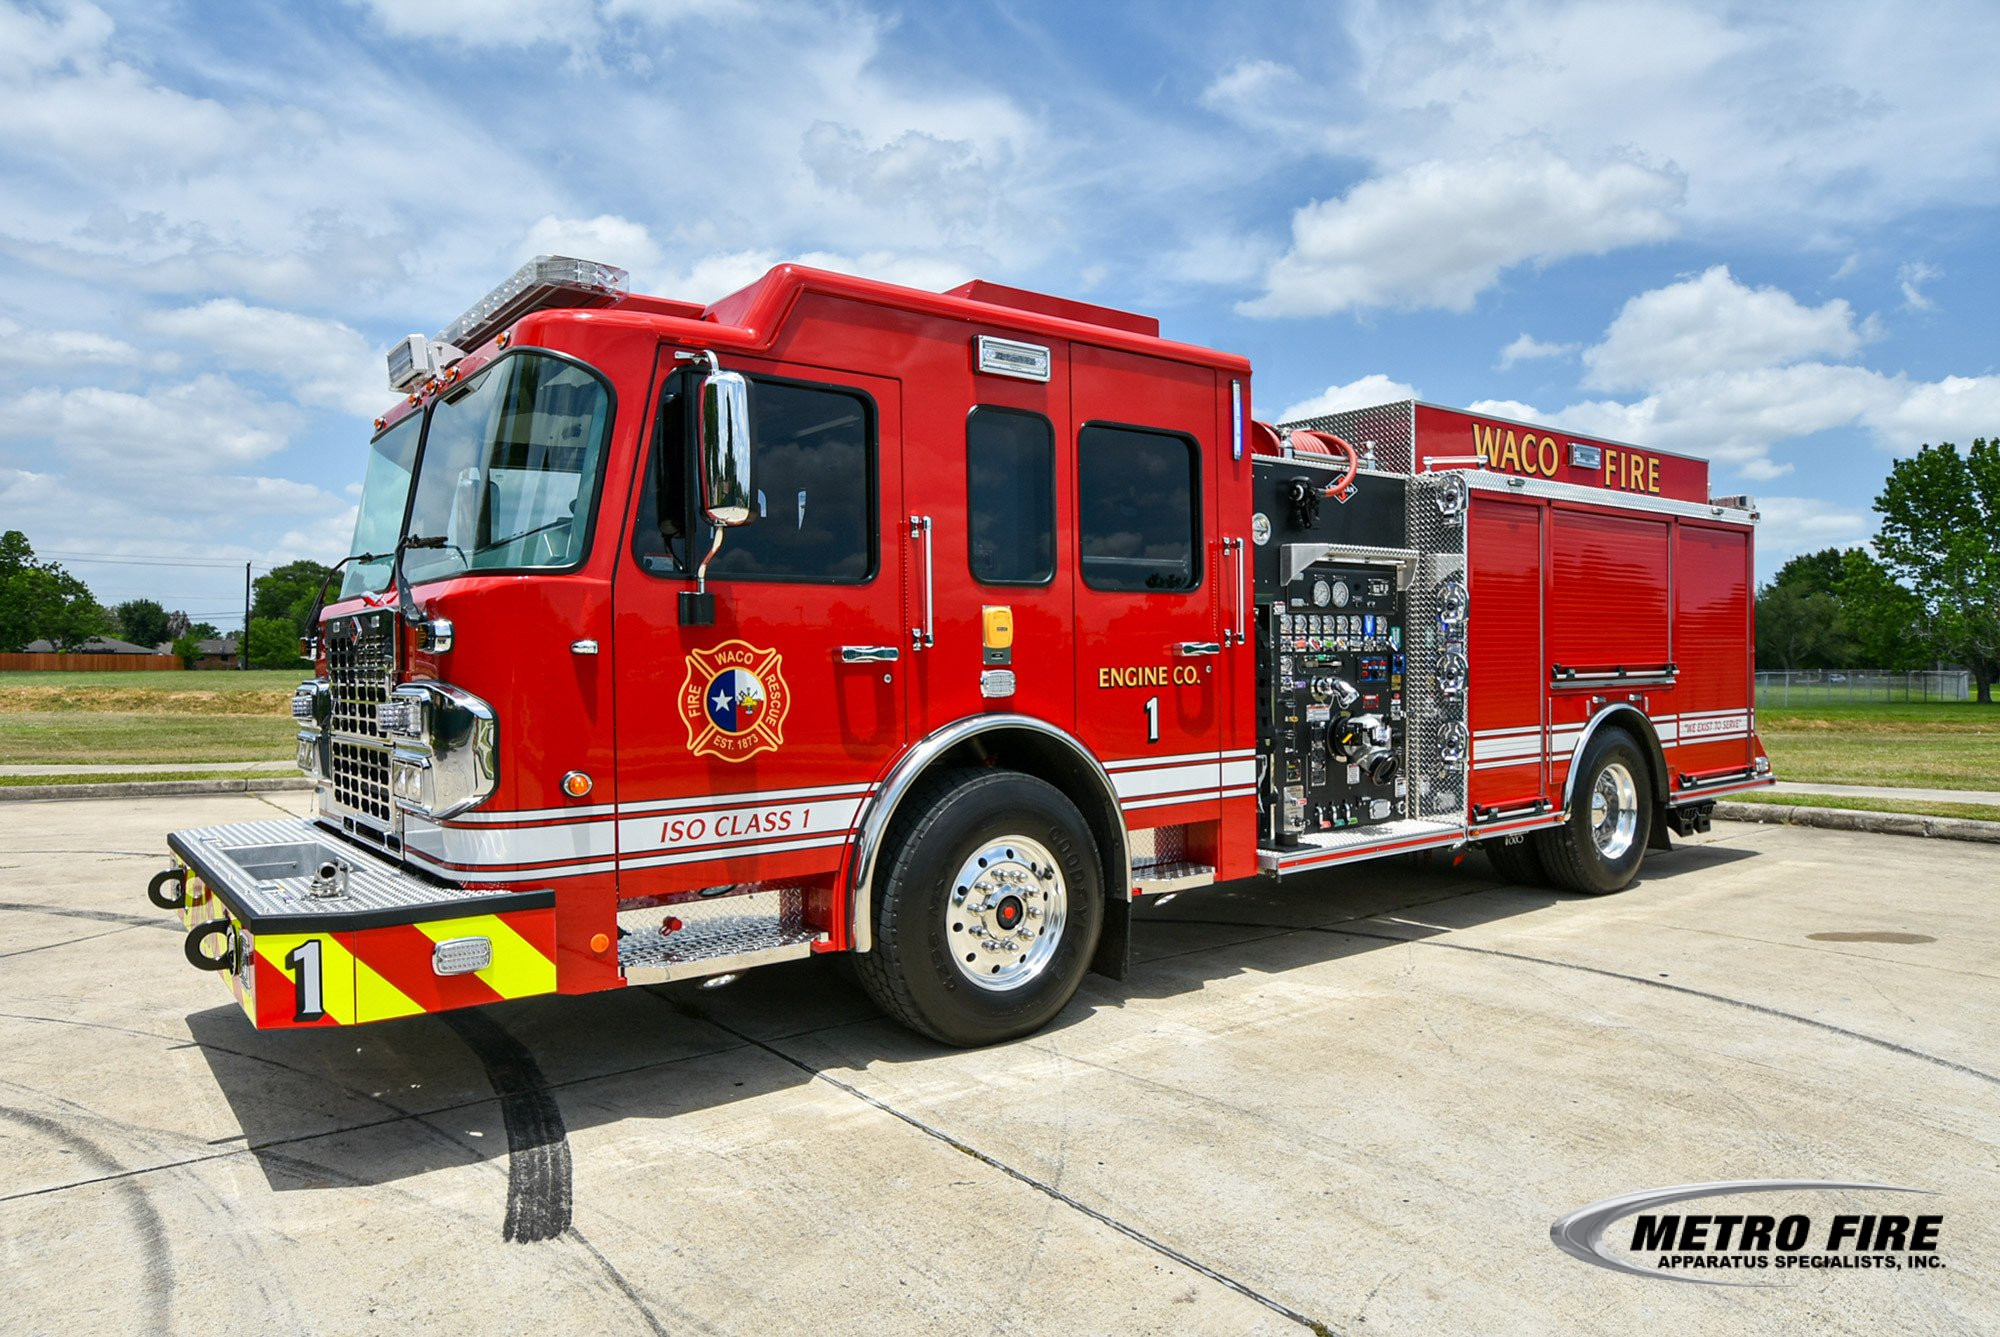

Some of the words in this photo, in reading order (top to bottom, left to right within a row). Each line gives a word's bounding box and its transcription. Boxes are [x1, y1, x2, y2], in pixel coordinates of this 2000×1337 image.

[1473, 423, 1559, 477] WACO
[1604, 448, 1660, 493] FIRE
[714, 650, 754, 666] WACO
[1099, 666, 1168, 688] ENGINE
[1173, 665, 1201, 685] CO.
[688, 684, 702, 718] FIRE
[765, 674, 781, 727] RESCUE
[1145, 696, 1159, 742] 1
[1697, 721, 1713, 732] EXIST
[1714, 721, 1721, 730] TO
[713, 735, 735, 750] EST.
[737, 733, 759, 750] 1873
[660, 819, 706, 844] ISO
[714, 810, 792, 837] CLASS
[802, 808, 811, 829] 1
[286, 940, 323, 1020] 1
